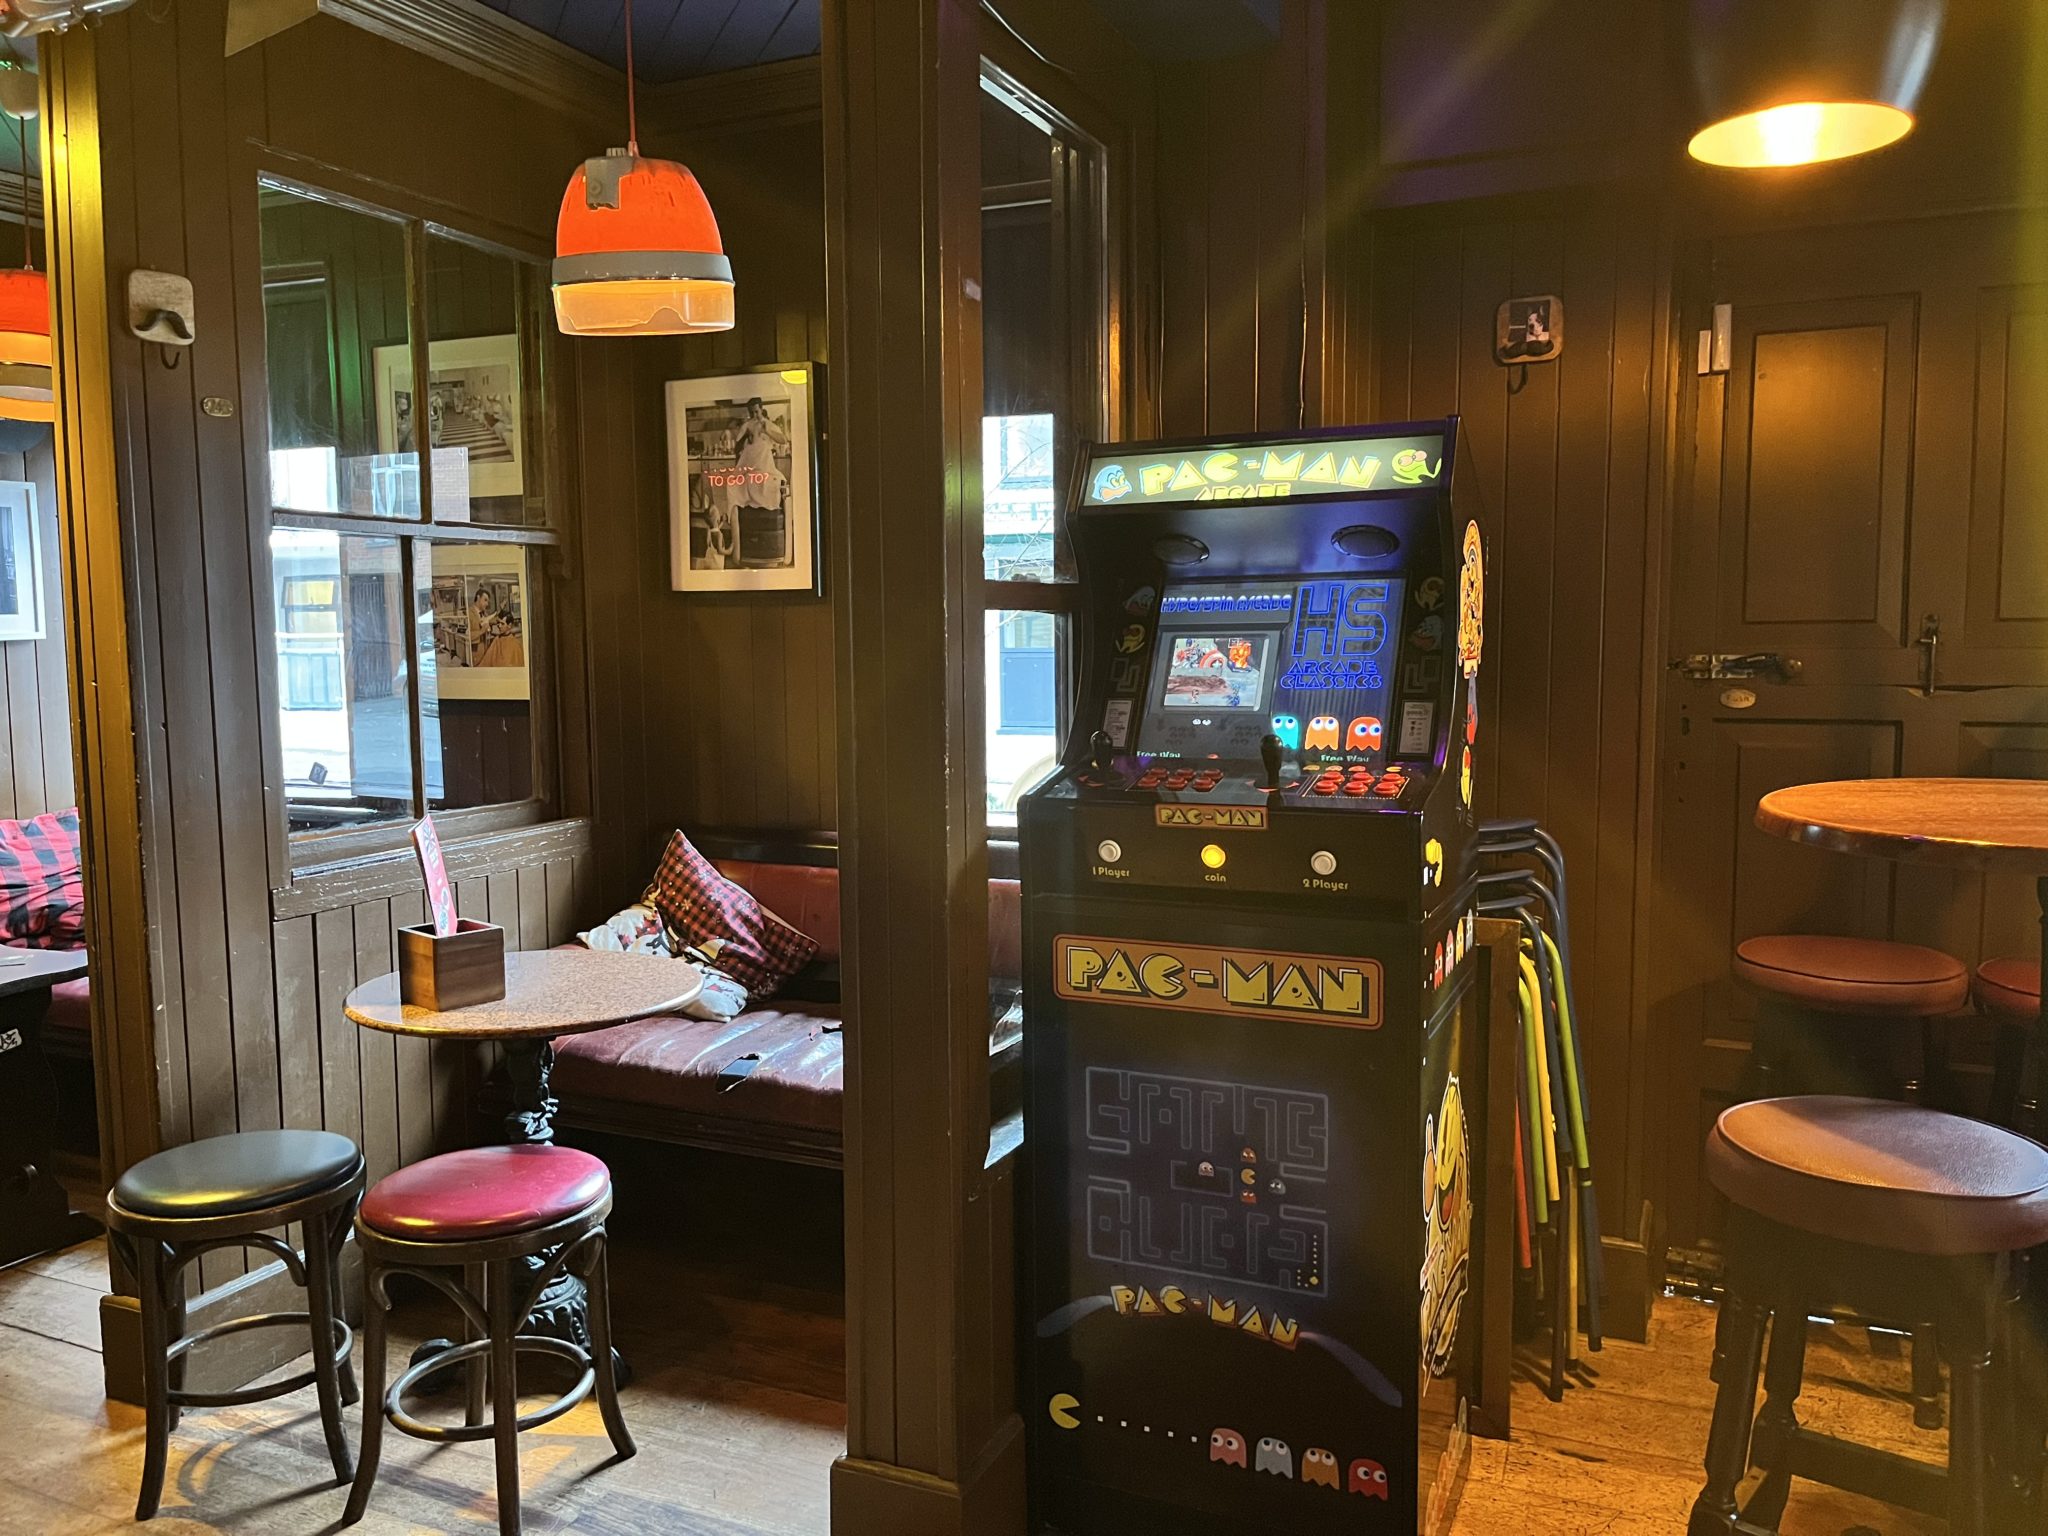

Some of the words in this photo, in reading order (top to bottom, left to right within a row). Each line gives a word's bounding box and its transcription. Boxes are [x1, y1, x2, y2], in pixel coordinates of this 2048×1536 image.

[708, 475, 724, 487] TO
[727, 474, 745, 486] GO
[749, 472, 770, 484] TO?
[1139, 449, 1379, 495] PAC-MAN
[1194, 482, 1292, 501] ARCADE
[1292, 584, 1389, 657] HS
[1287, 659, 1379, 675] ARCADE
[1280, 674, 1383, 690] CLASSICS
[1160, 807, 1264, 828] PAC-MAN
[1098, 867, 1130, 880] Player
[1204, 872, 1227, 883] coin
[1302, 879, 1311, 889] 2
[1313, 880, 1349, 893] Player
[1066, 945, 1370, 1019] PAC-MAN
[1109, 1284, 1300, 1345] PAC-MAN
